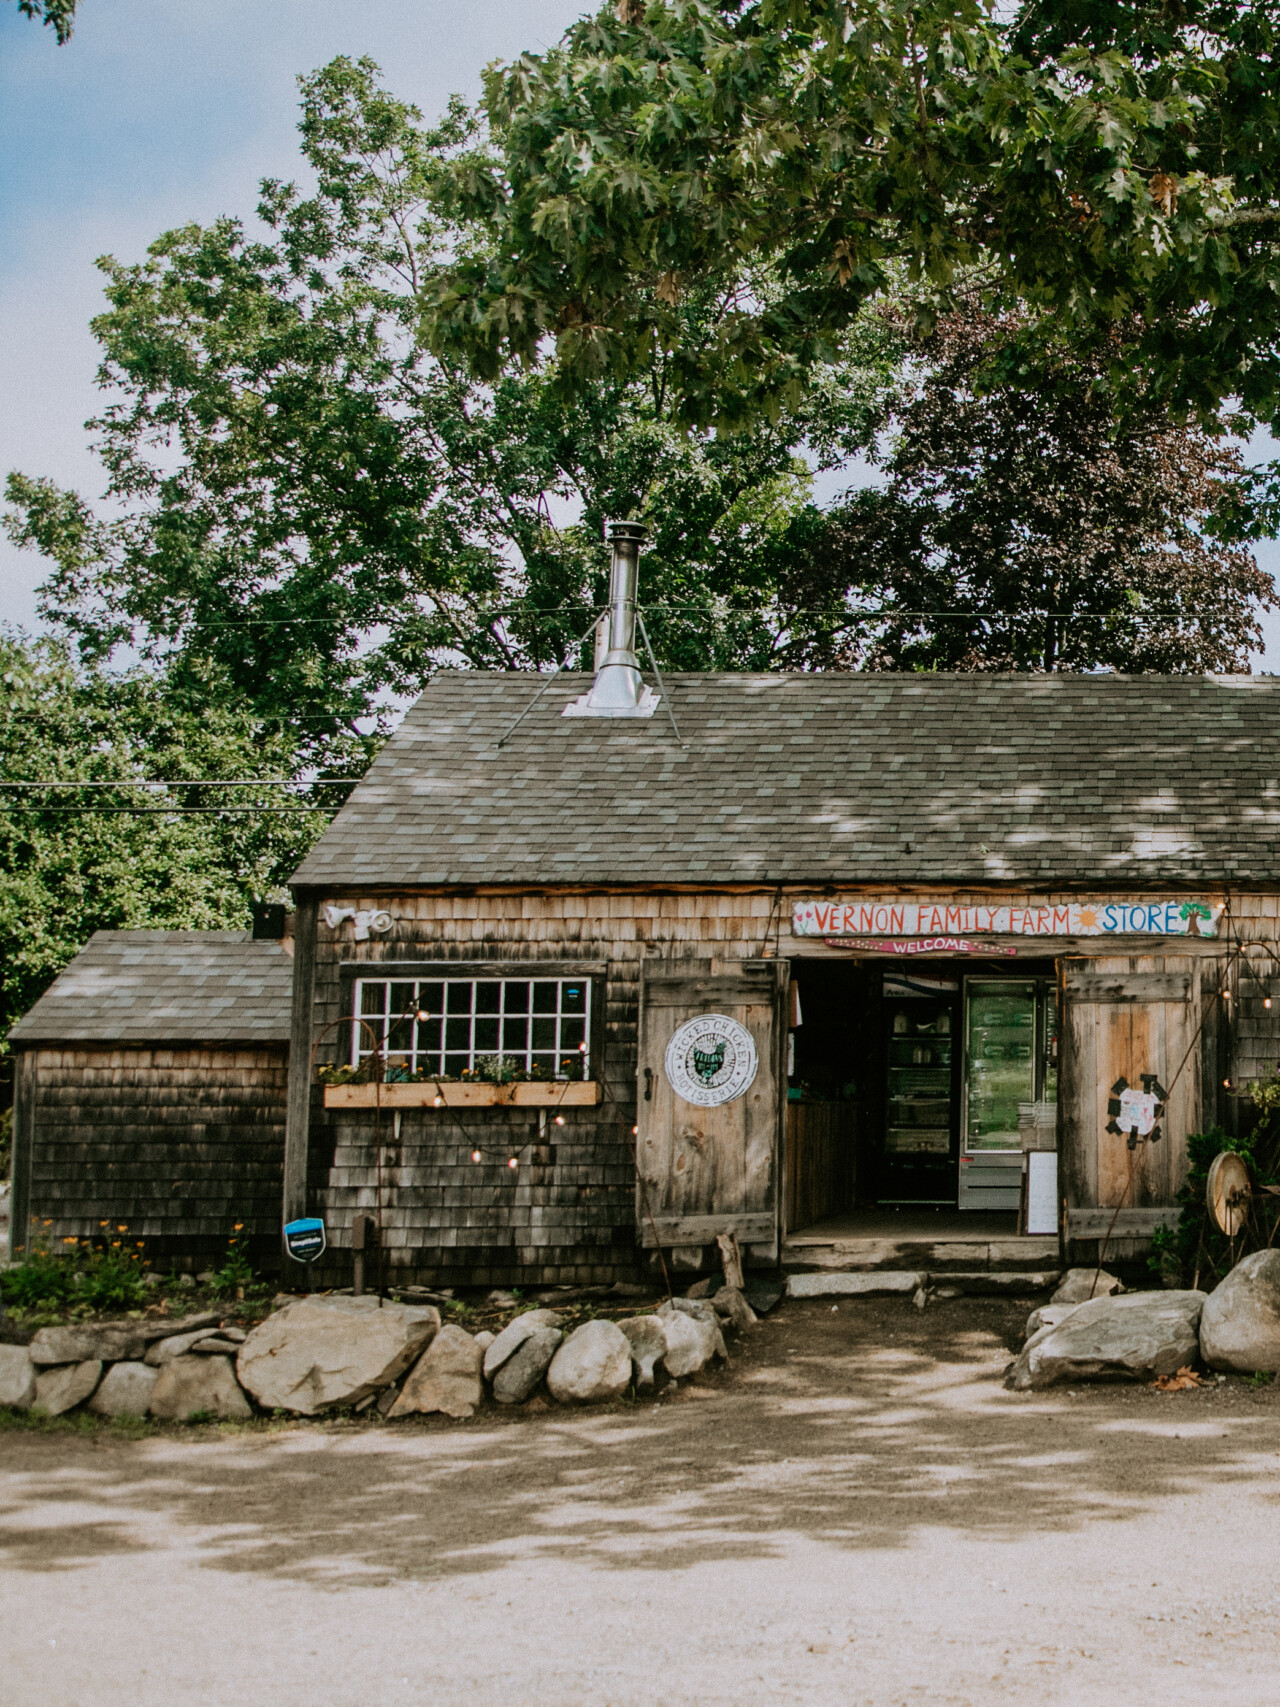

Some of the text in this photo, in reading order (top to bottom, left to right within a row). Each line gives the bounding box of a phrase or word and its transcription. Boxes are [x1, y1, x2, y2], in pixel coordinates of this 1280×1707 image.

[815, 905, 1180, 933] VERNON FAMILY FARM STORE
[893, 937, 970, 953] WELCOME
[676, 1021, 747, 1067] WICKED CHICKEN
[676, 1073, 739, 1101] ROTISSERIE
